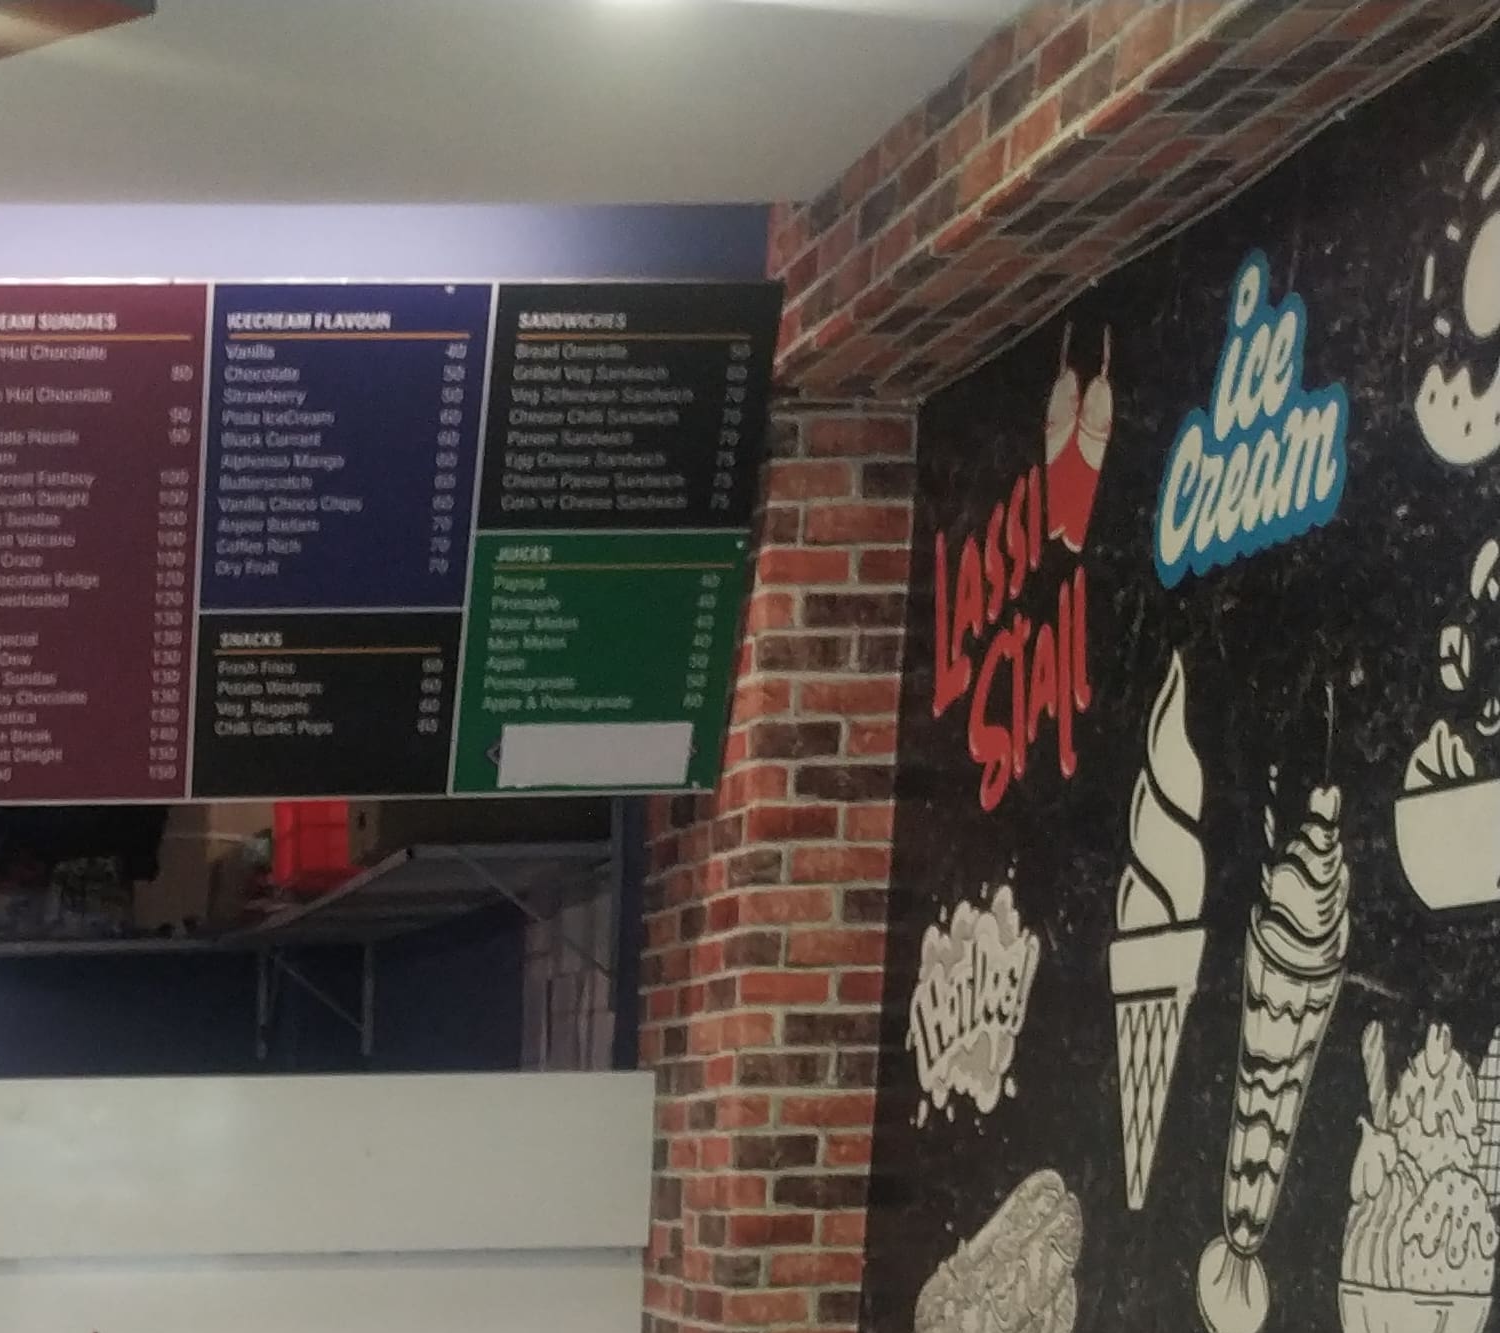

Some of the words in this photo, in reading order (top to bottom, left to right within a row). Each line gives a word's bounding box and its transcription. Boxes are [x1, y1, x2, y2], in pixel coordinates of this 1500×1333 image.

[37, 313, 117, 330] SUNDAES
[227, 313, 312, 329] ICECREAM
[313, 312, 391, 329] FLAVOUR
[519, 312, 626, 328] SANDWICHES
[1214, 266, 1298, 441] ice
[1159, 400, 1338, 566] Cream
[932, 466, 1041, 717] LASSI
